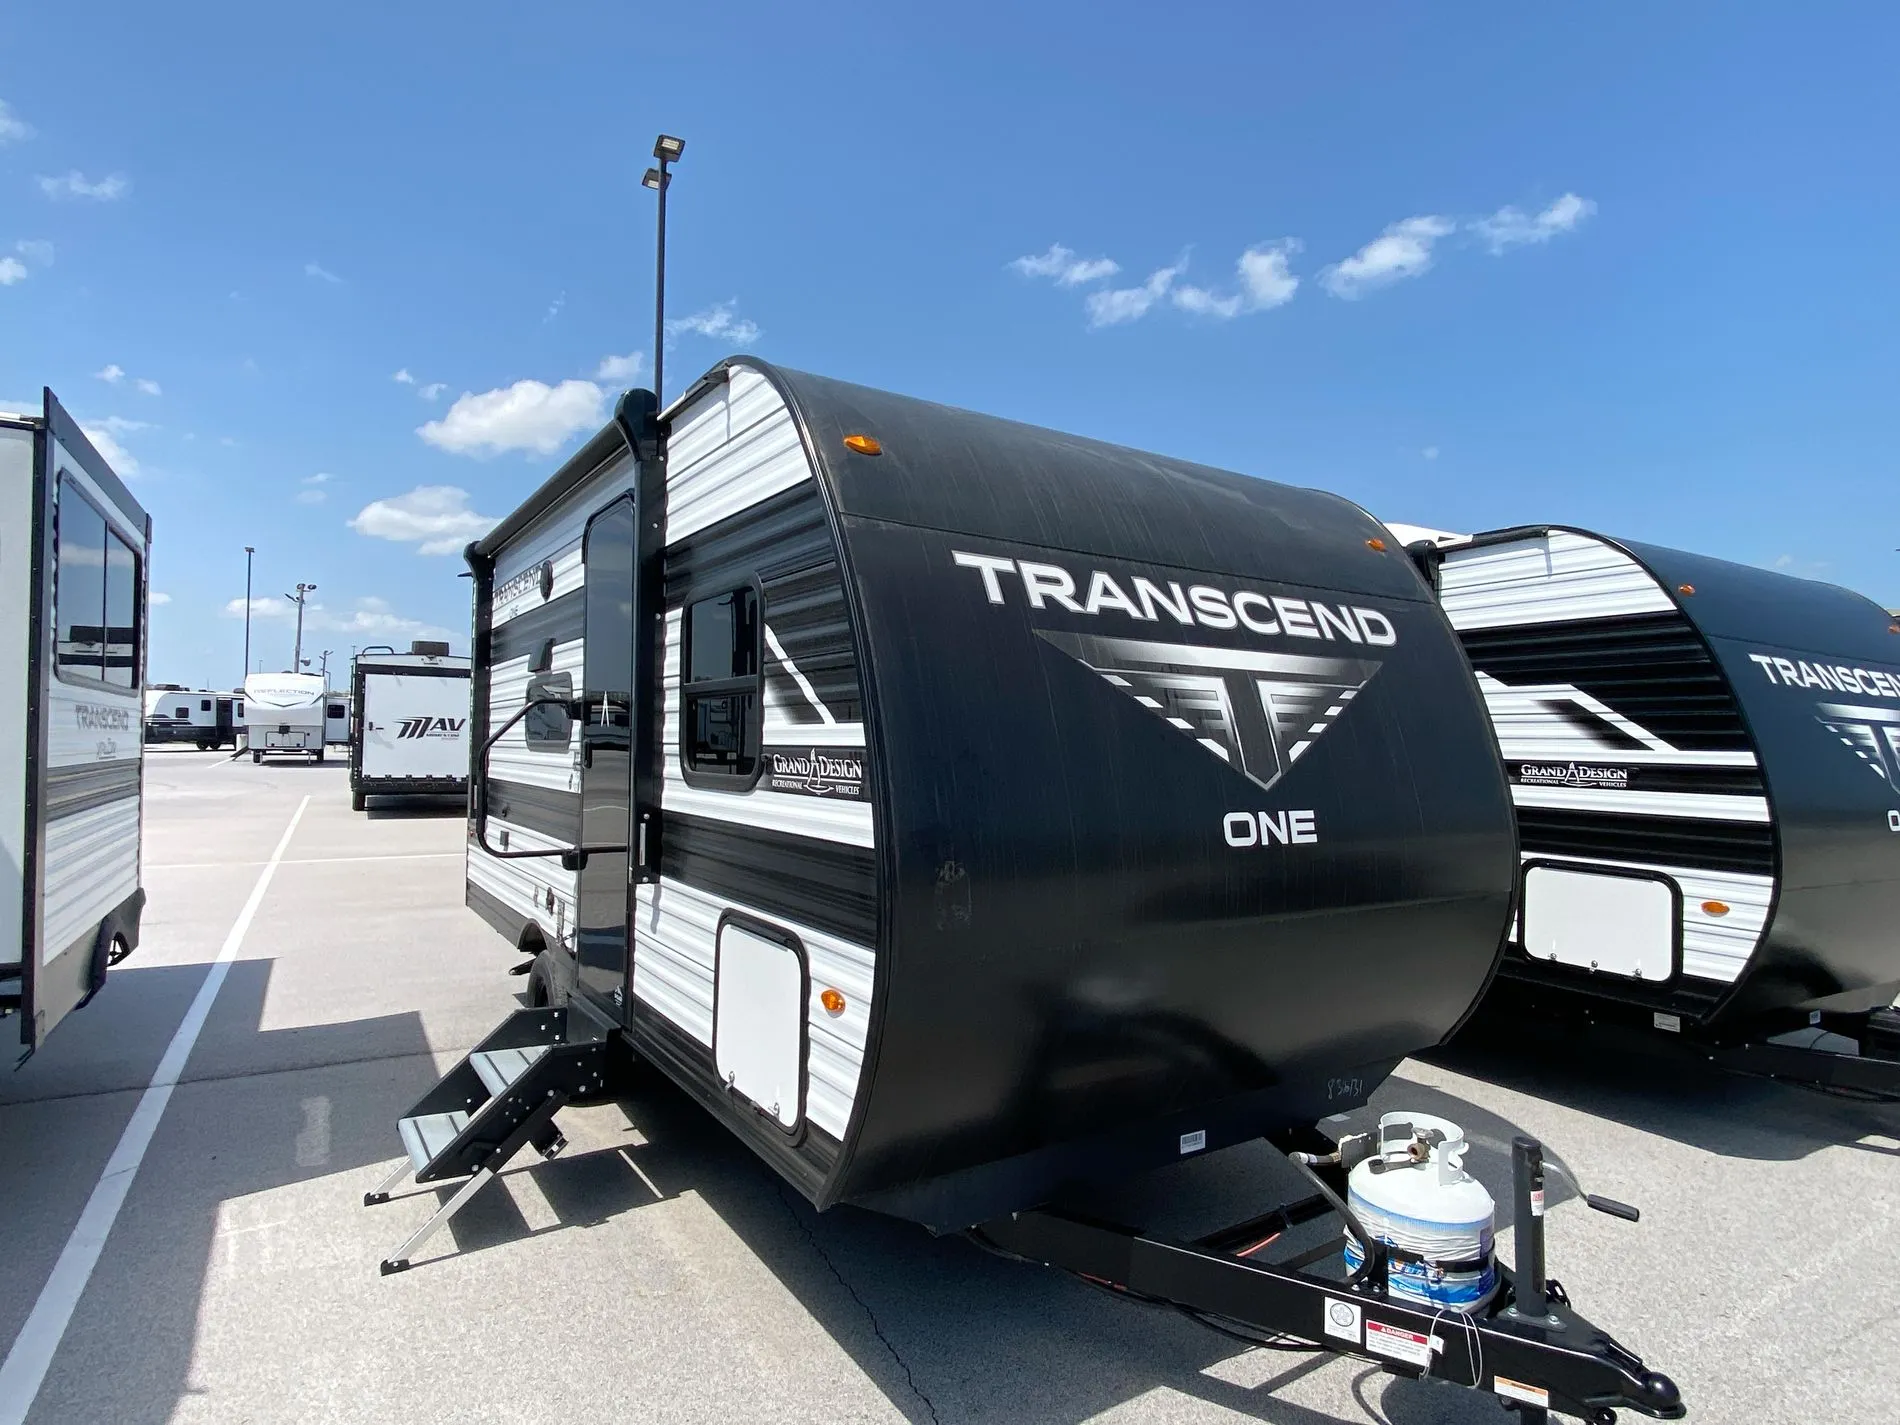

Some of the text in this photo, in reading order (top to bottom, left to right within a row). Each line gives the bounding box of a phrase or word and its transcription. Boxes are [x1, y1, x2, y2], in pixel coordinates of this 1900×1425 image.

[951, 550, 1397, 647] TRANSCEND
[773, 754, 862, 778] GRAND DESIGN
[1520, 764, 1628, 779] GRAND DESIGN
[772, 779, 860, 795] RECREATIONAL VEHICLES
[1599, 780, 1627, 788] VEHICLES
[1223, 809, 1318, 848] ONE
[1388, 1327, 1415, 1341] DANGER
